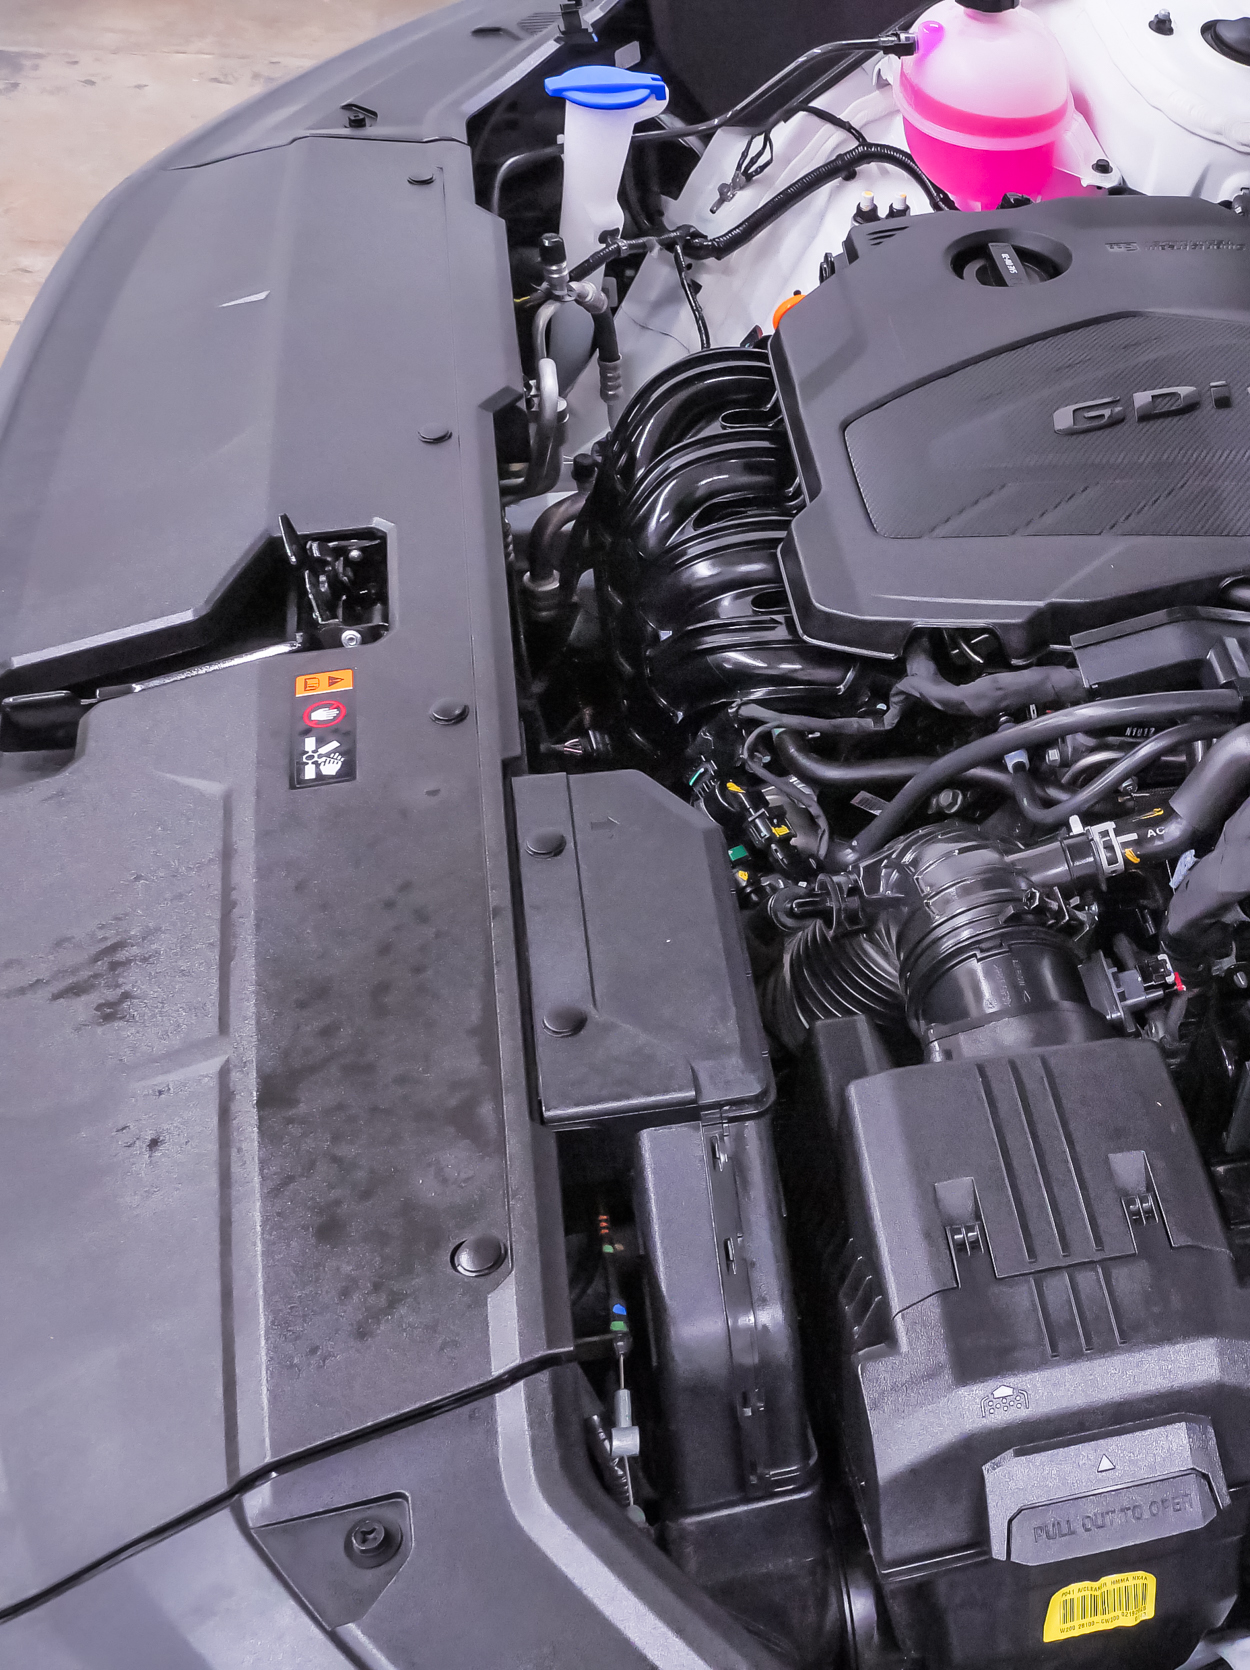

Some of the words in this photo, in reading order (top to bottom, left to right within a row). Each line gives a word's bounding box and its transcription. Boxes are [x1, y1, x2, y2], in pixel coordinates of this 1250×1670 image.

[1033, 1519, 1077, 1543] PULL
[1081, 1508, 1116, 1532] OUT
[1120, 1504, 1144, 1521] TO
[1149, 1493, 1194, 1517] OPEN
